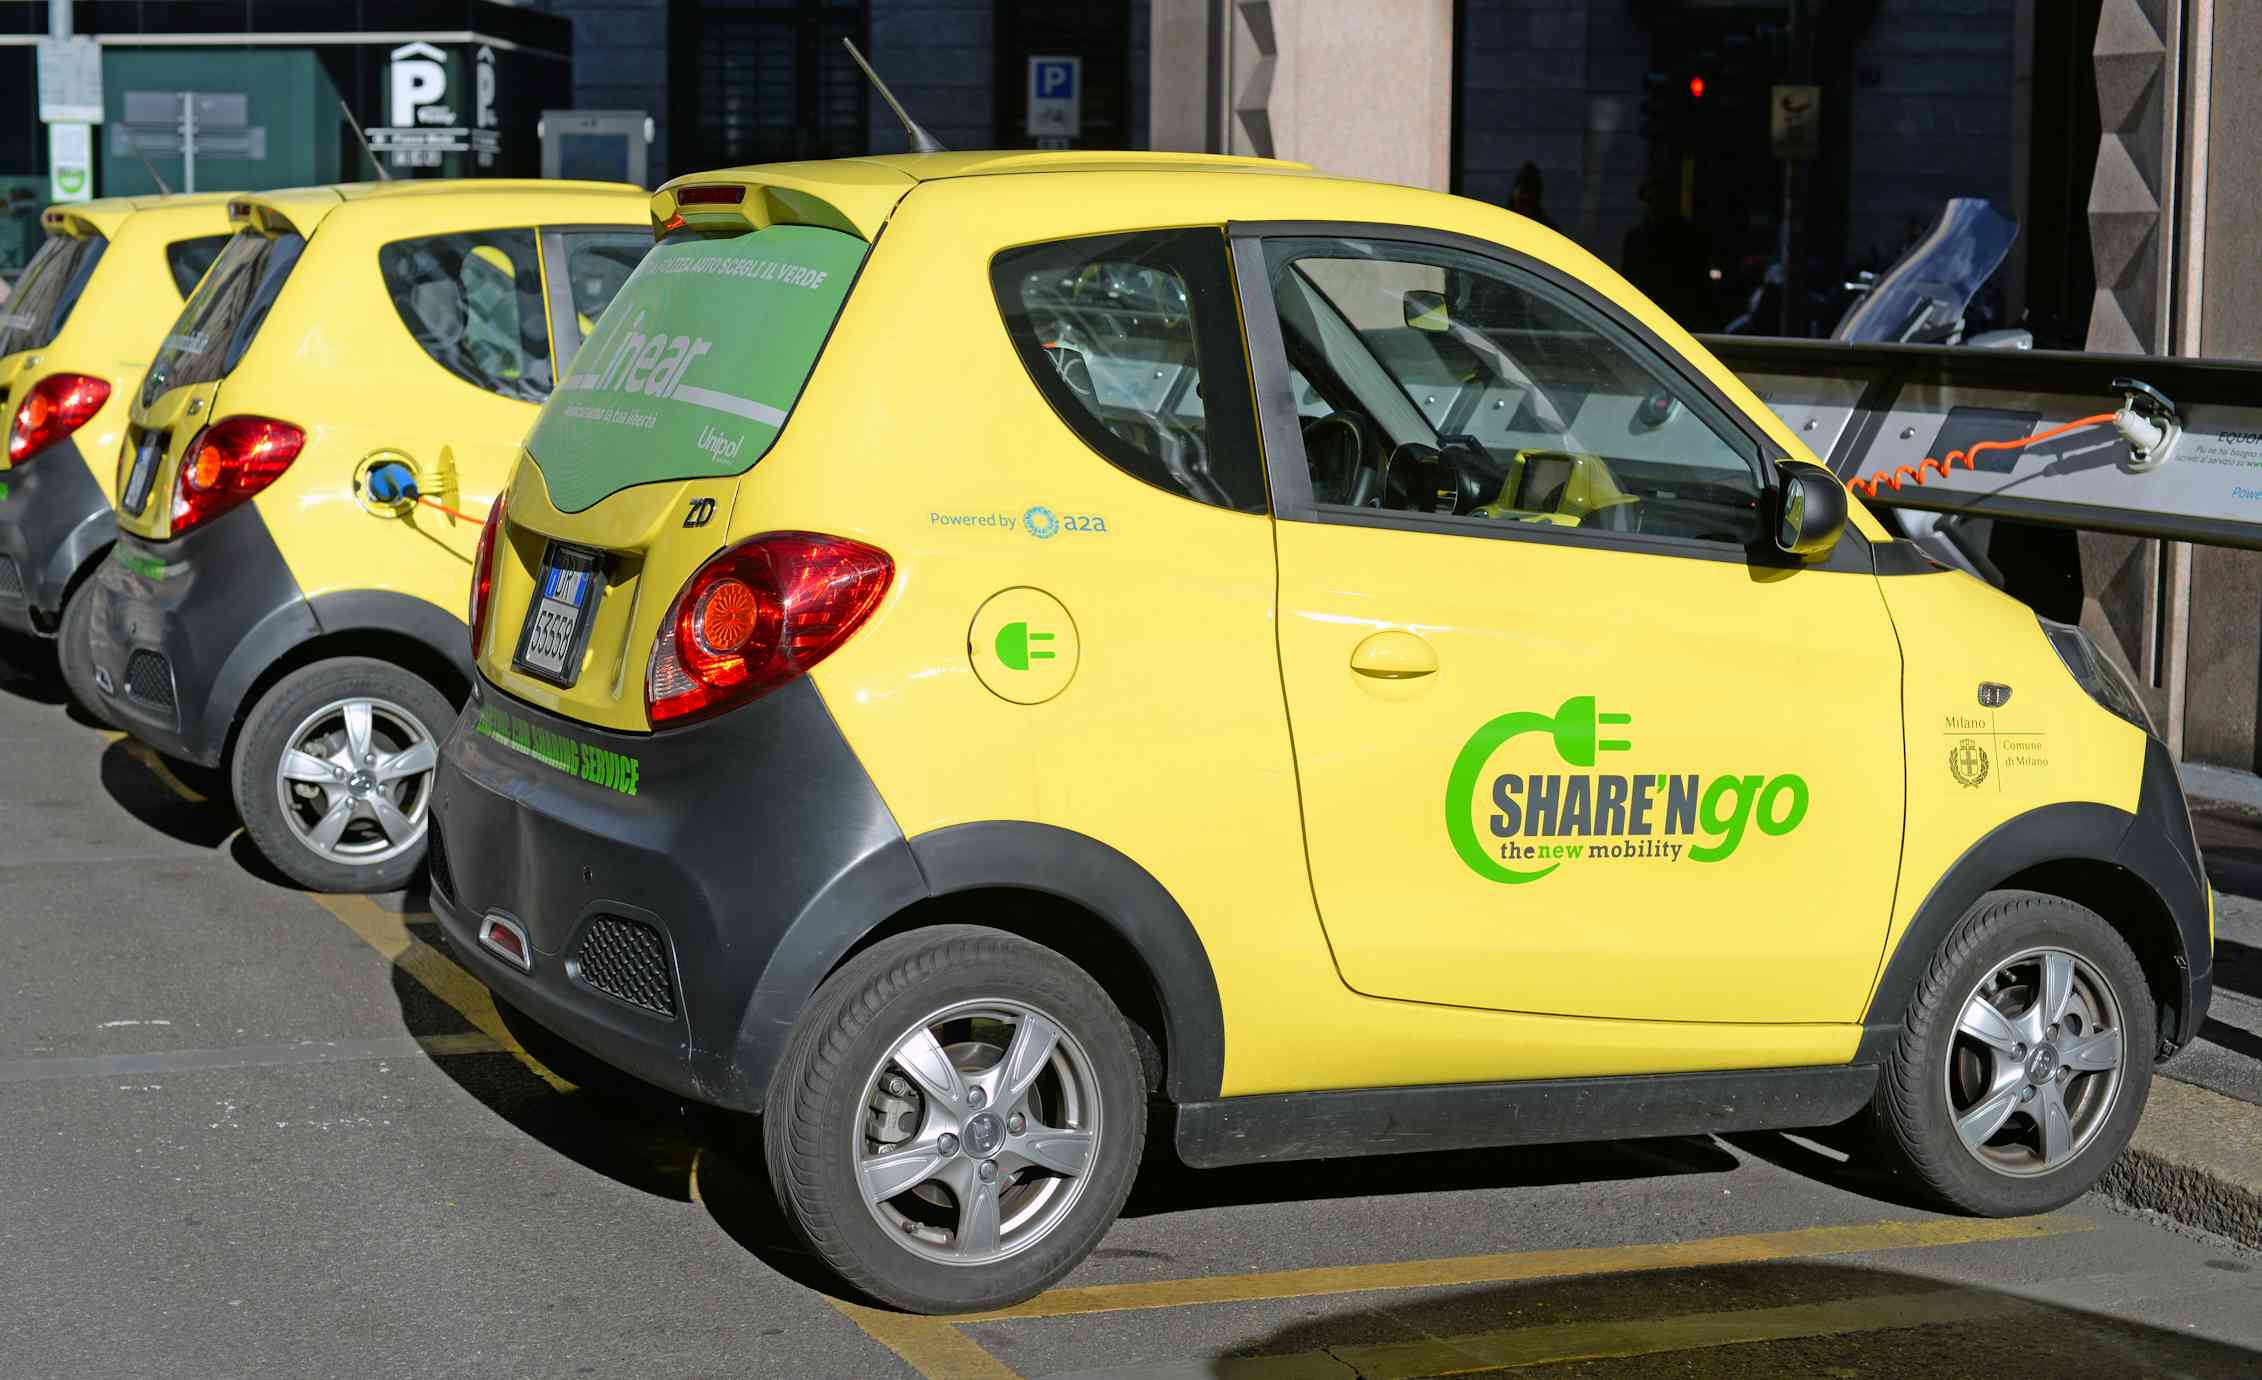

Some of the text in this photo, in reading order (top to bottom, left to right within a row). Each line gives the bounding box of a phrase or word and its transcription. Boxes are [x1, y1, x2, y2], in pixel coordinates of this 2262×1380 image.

[1045, 66, 1066, 95] P
[391, 60, 447, 128] P
[776, 263, 828, 289] VERDE
[698, 425, 745, 462] Unipol
[930, 512, 1108, 532] Powered by a2a
[1945, 716, 1987, 729] Milano
[2002, 740, 2043, 752] Comune
[580, 743, 640, 796] SERVICE
[2004, 756, 2049, 769] di Milano
[1500, 840, 1683, 863] the new mobility
